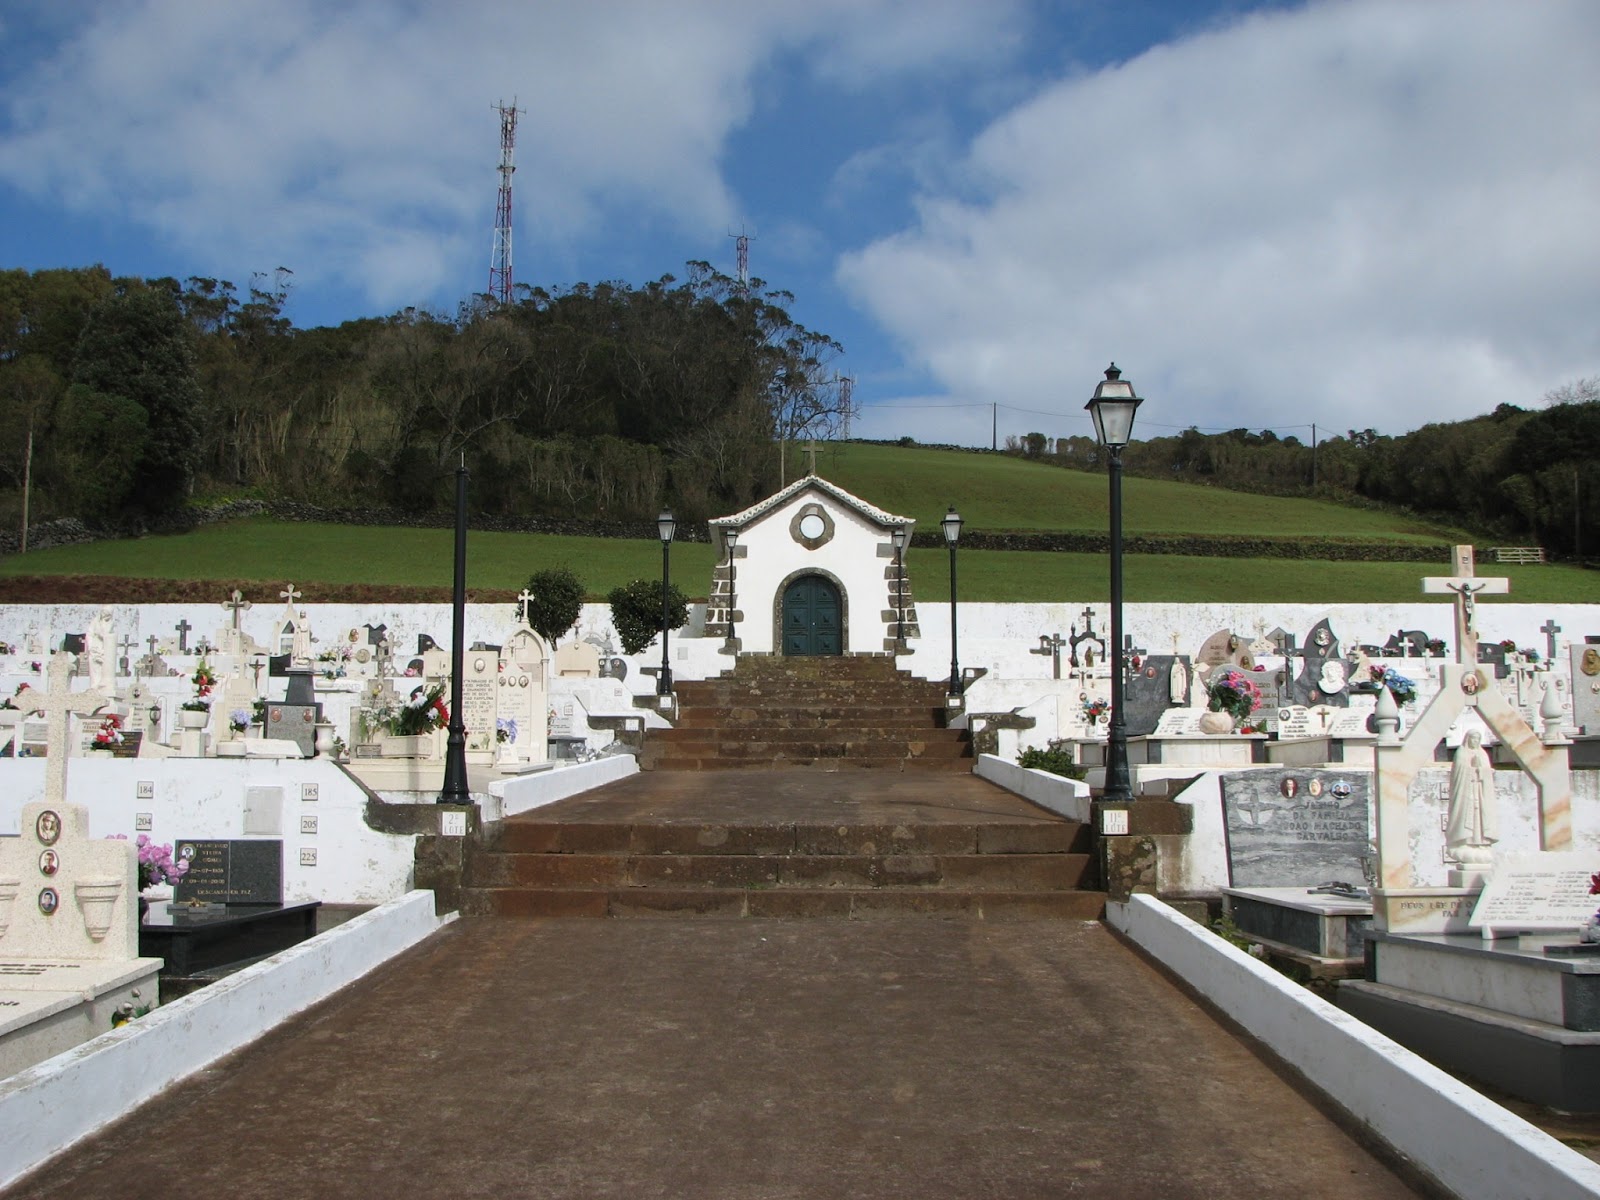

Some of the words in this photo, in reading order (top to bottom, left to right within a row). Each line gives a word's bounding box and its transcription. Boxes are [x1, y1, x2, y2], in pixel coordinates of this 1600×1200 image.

[139, 785, 153, 795] 184
[304, 787, 318, 797] 185
[137, 817, 152, 827] 204
[302, 819, 317, 829] 205
[443, 825, 465, 835] LOTE
[1105, 823, 1127, 833] LOTE
[301, 851, 316, 862] 225
